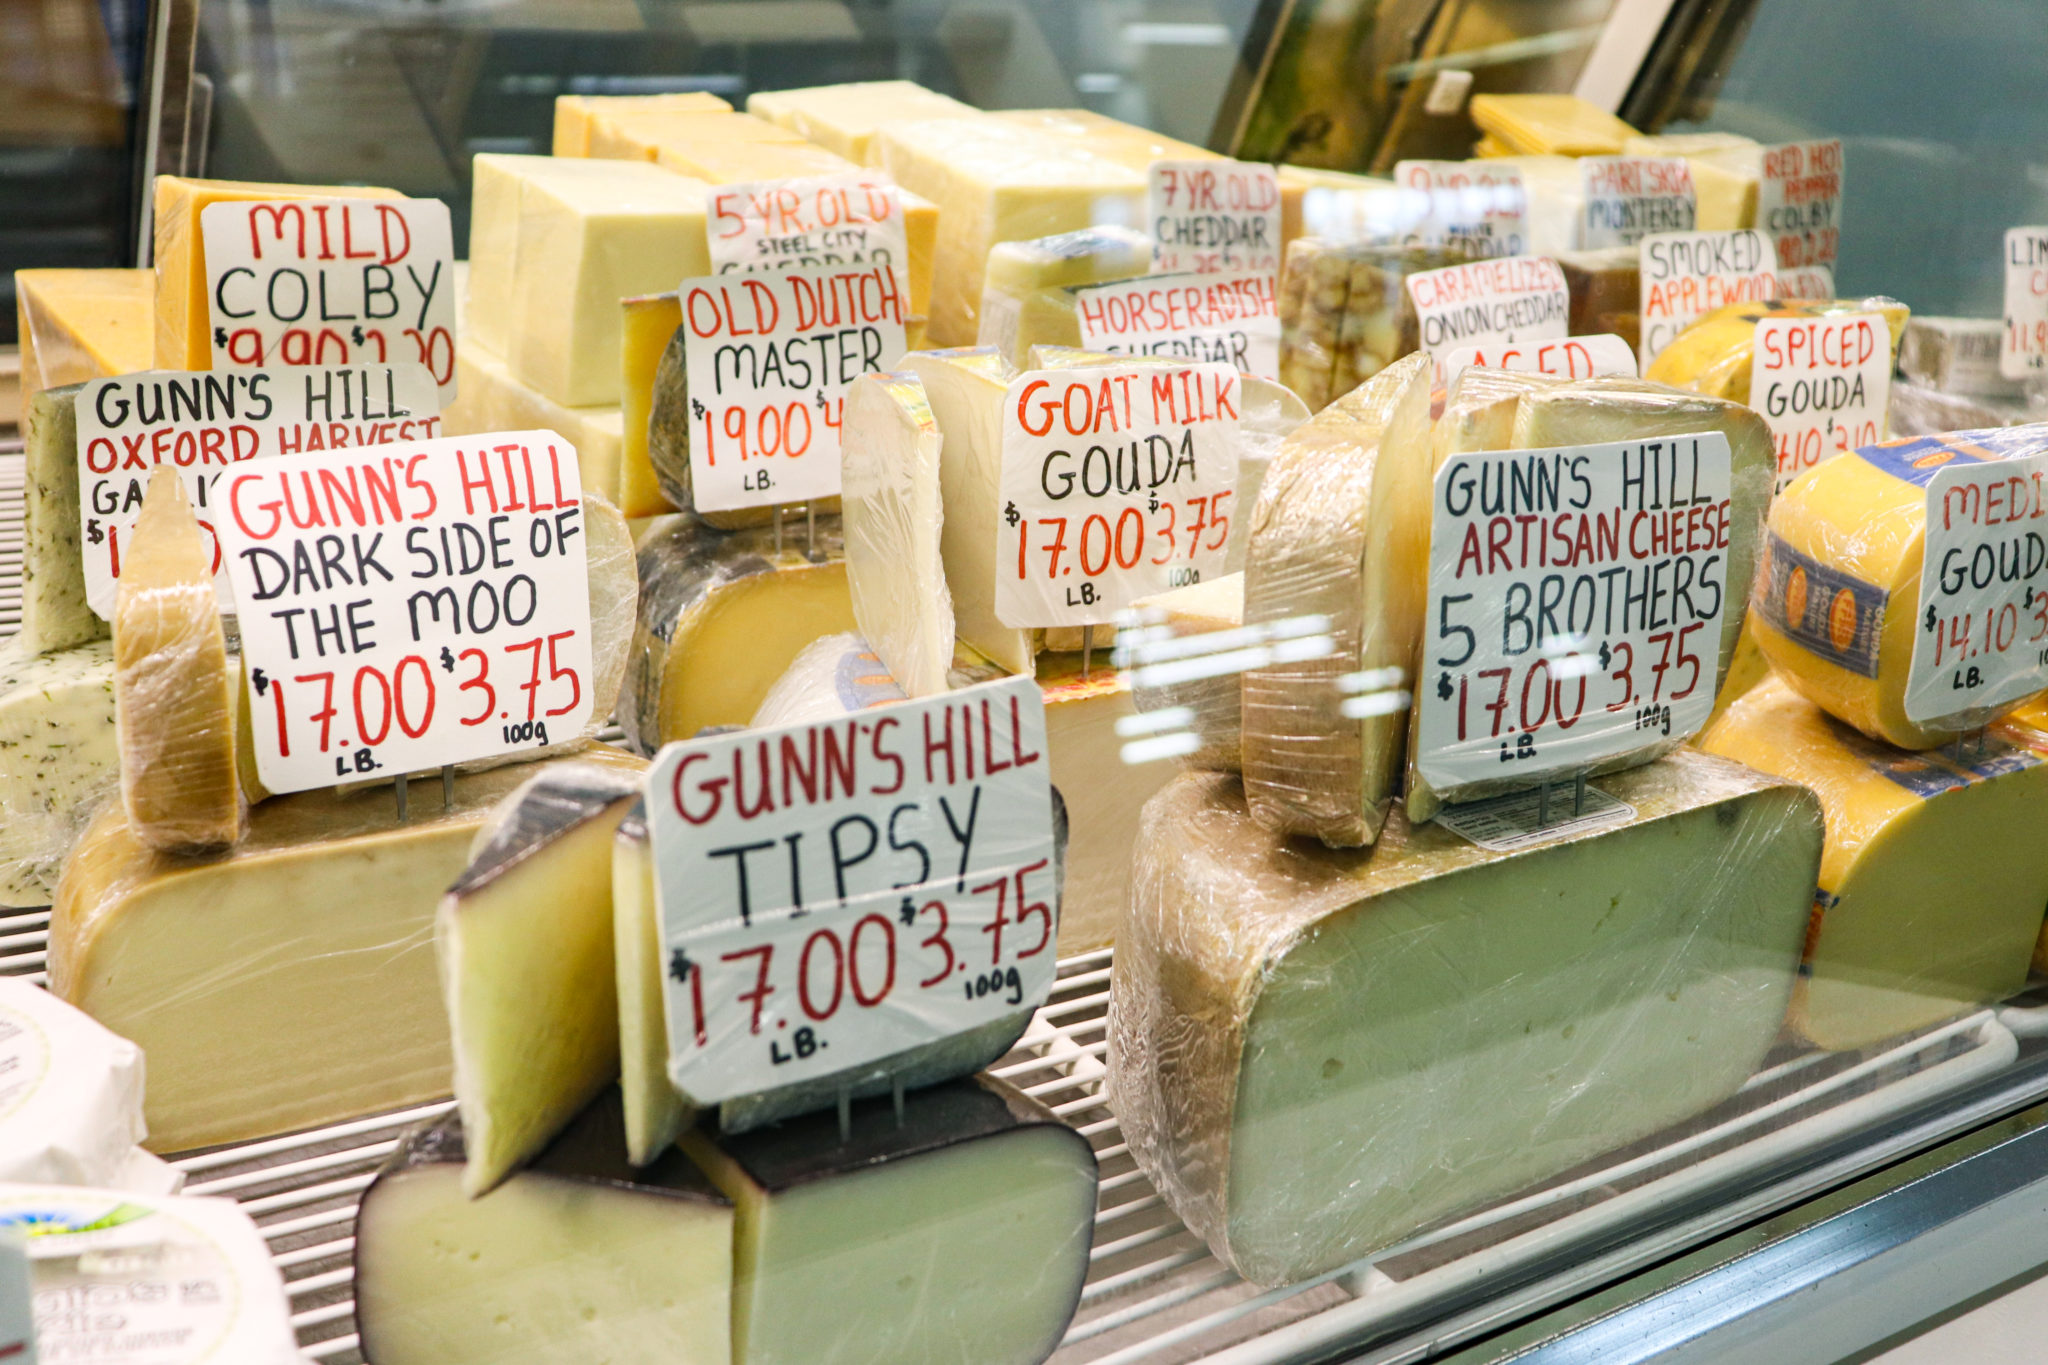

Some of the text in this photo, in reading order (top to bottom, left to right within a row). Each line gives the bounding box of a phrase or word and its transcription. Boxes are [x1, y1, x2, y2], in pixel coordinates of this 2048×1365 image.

[1160, 170, 1178, 206] 7
[1227, 173, 1278, 212] OLD
[1765, 144, 1803, 179] RED
[249, 203, 411, 265] MILD
[715, 194, 746, 239] 5
[816, 183, 891, 228] OLD
[757, 229, 867, 256] STEEL CITY
[1157, 214, 1270, 250] CHEDDAR
[1768, 200, 1832, 230] COLBY
[1413, 256, 1563, 308] CARAMELIZED
[1650, 230, 1761, 279] SMOKED
[216, 261, 441, 329] COLBY
[687, 264, 903, 338] OLD DUTCH
[1081, 277, 1280, 338] HORSERADISH
[1425, 292, 1568, 346] ONION CHEDDAR
[714, 326, 882, 394] MASTER
[1764, 321, 1874, 370] SPICED
[96, 368, 411, 429] GUNN'S HILL
[1017, 370, 1238, 437] GOAT MILK
[1767, 372, 1866, 418] GOUDA
[87, 416, 440, 474] OXFORD HARVEST
[691, 397, 812, 466] $19.00
[1041, 428, 1197, 500] GOUDA
[230, 445, 578, 540] GUNN'S HILL
[744, 469, 776, 491] LB.
[1445, 439, 1712, 517] GUNN'S HILL
[240, 532, 393, 600] DARK
[407, 516, 513, 578] SIDE
[530, 509, 579, 557] OF
[1004, 489, 1233, 580] $17.00 $3.75
[1455, 498, 1731, 579] ARTISAN CHEESE
[1940, 531, 2048, 596] GOUD
[271, 574, 537, 659] THE MOO
[1066, 581, 1101, 607] LB.
[1438, 592, 1477, 667] 5
[1502, 555, 1721, 657] BROTHERS
[1926, 602, 2017, 667] $14.10
[252, 630, 581, 757] $17.00 $3.75
[1437, 621, 1705, 742] $17.00 $3.75
[1953, 666, 1984, 690] LB.
[336, 721, 548, 775] LB. 100g
[1635, 704, 1671, 736] 100g
[672, 695, 1040, 826] GUNN'S HILL
[707, 786, 980, 927] TIPSY
[669, 859, 1052, 1047] $17.00 $3.75
[771, 966, 1023, 1065] LB. 100g
